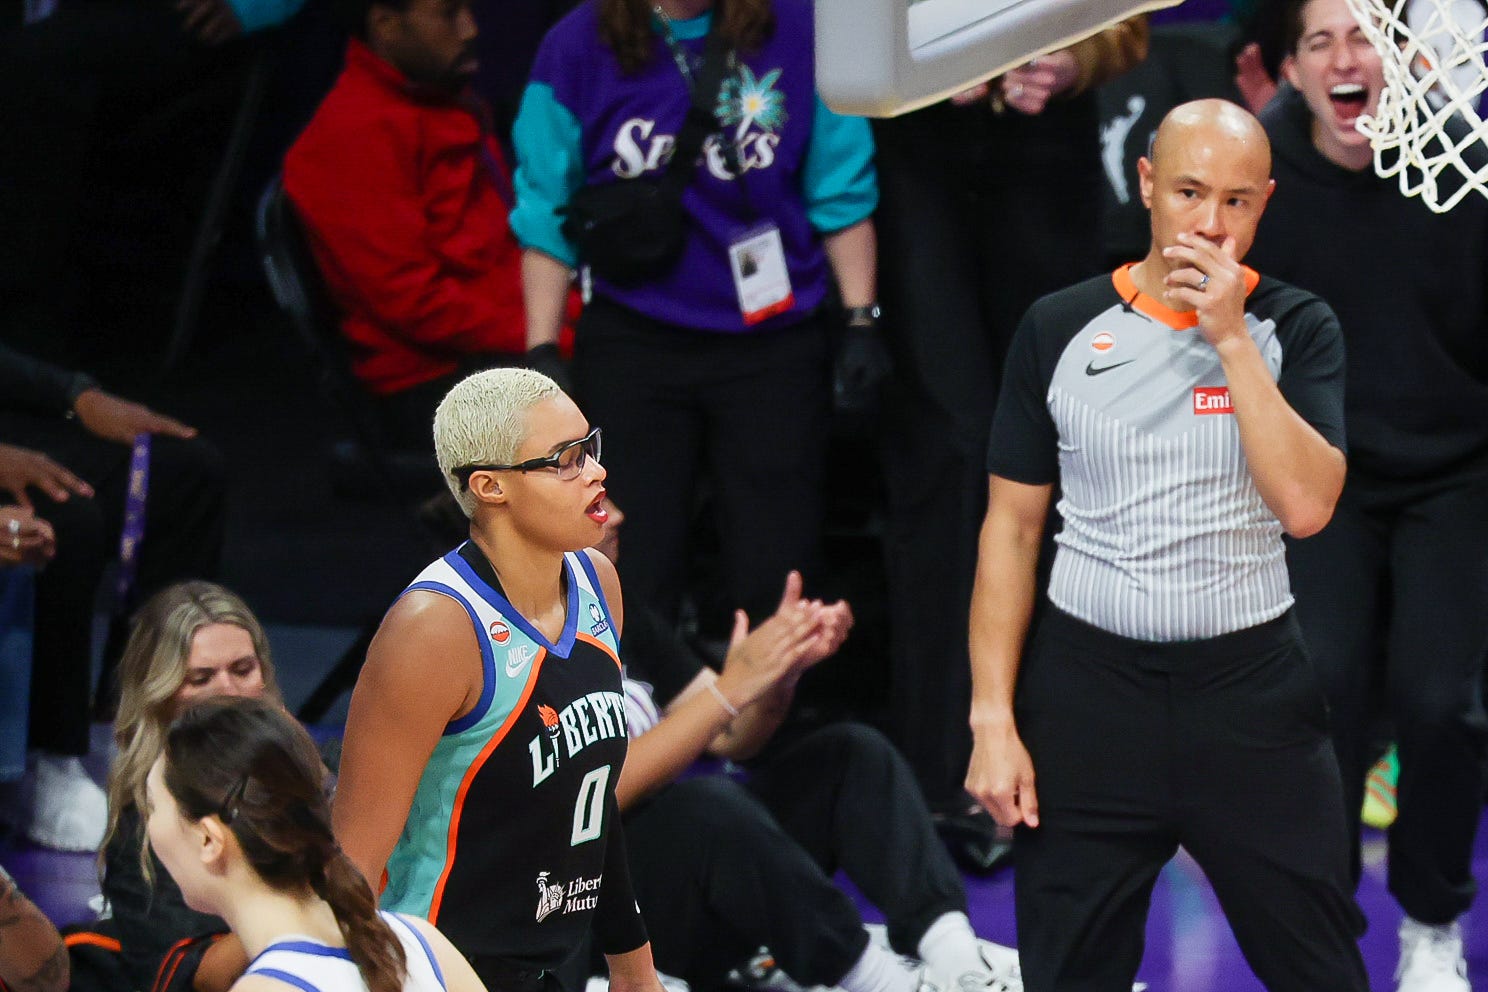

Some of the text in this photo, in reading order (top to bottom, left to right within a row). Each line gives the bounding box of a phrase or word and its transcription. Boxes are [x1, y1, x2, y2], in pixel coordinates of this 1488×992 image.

[529, 691, 628, 789] LIBERT
[571, 764, 611, 847] 0
[567, 873, 602, 898] Liber
